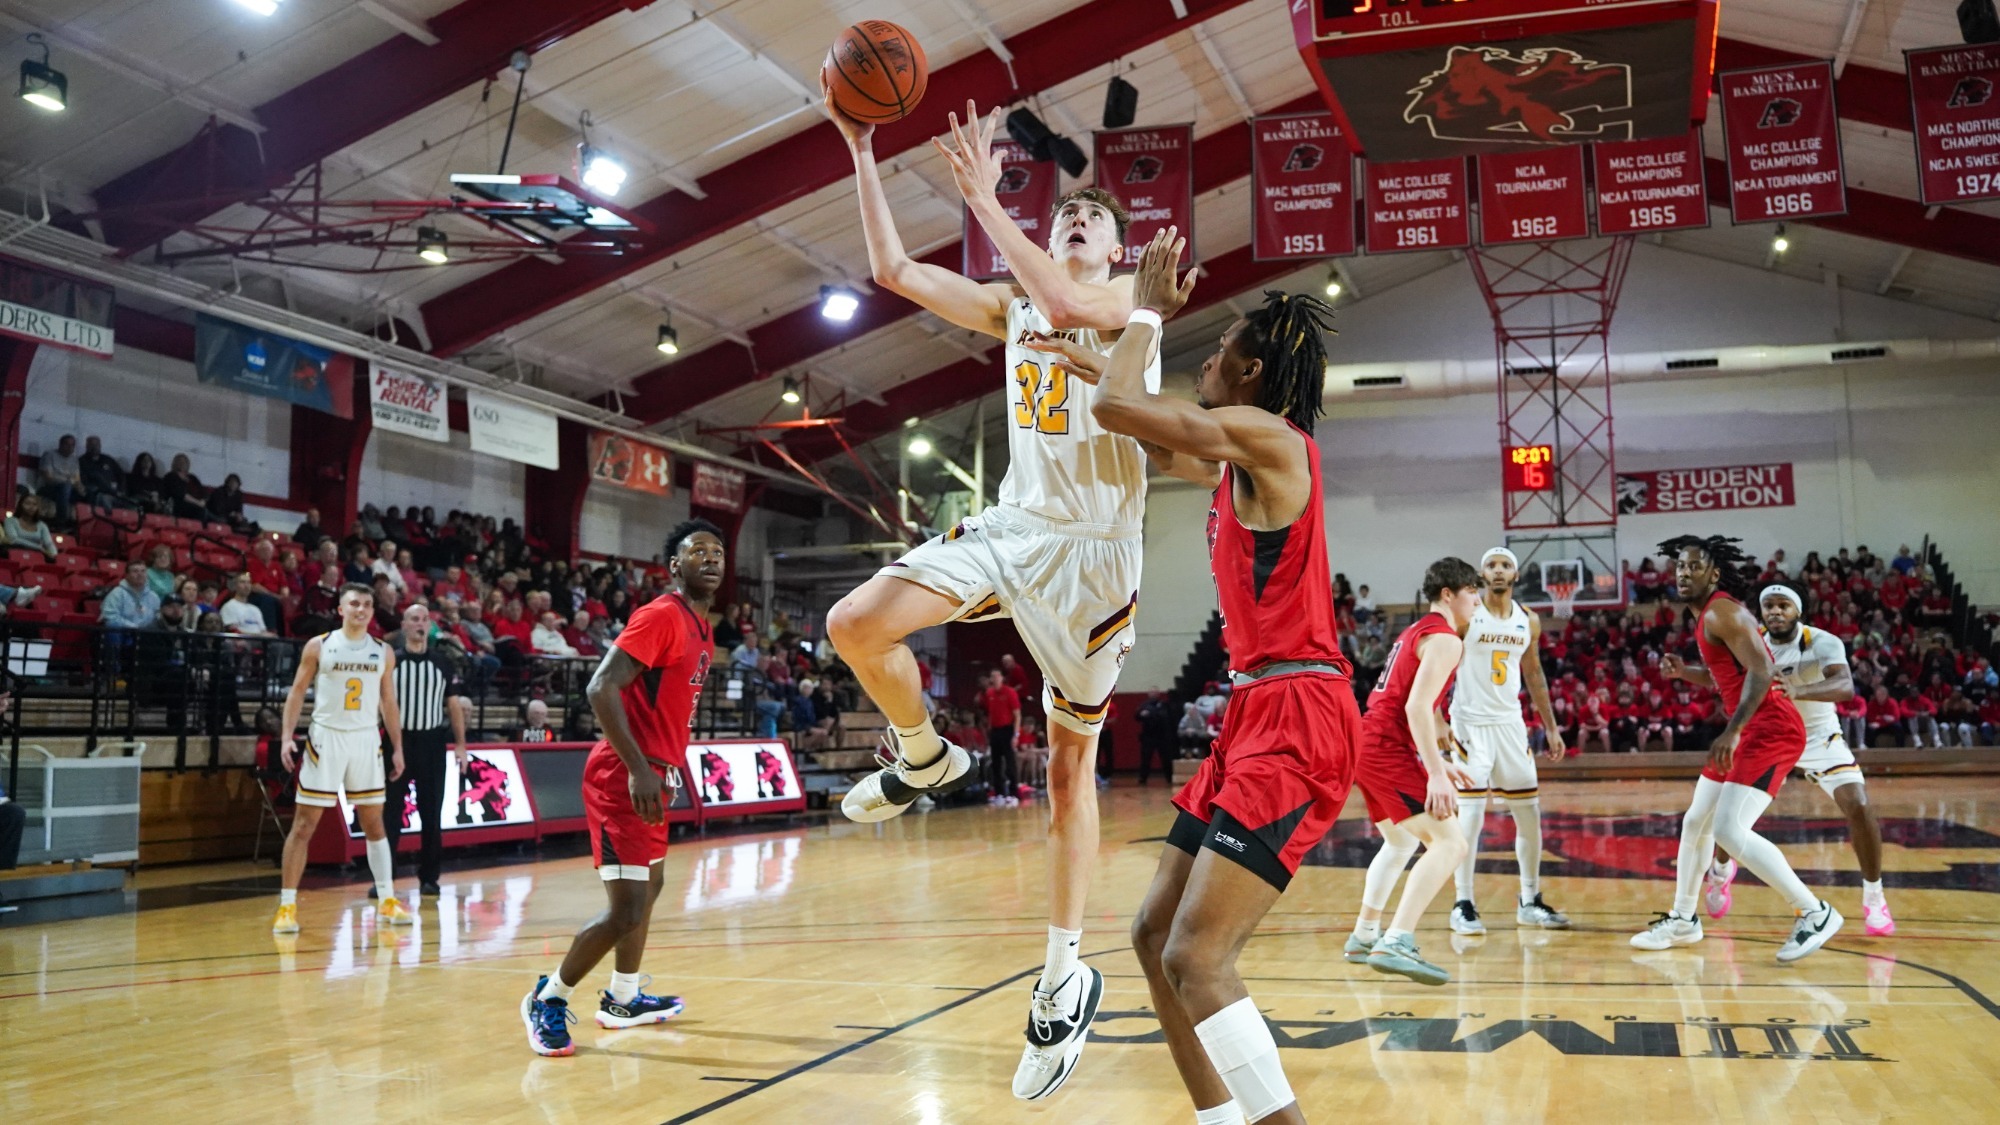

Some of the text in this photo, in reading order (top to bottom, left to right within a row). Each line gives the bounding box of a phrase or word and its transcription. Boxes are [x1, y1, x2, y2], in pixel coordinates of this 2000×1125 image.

[1379, 10, 1419, 28] T.O.L.
[1752, 71, 1795, 84] MEN'S
[1733, 78, 1821, 98] BASKETBALL
[1263, 126, 1342, 142] BASKETBALL
[1928, 123, 1954, 136] MAC
[1743, 137, 1822, 156] MAC COLLEGE
[1609, 151, 1687, 169] MAC COLLEGE
[1750, 153, 1818, 171] CHAMPIONS
[1929, 153, 2000, 172] NCAA SWEE
[1515, 165, 1546, 178] NCAA
[1616, 166, 1682, 183] CHAMPIONS
[1265, 182, 1341, 198] MAC WESTERN
[1379, 173, 1451, 190] MAC COLLEGE
[1495, 177, 1567, 194] TOURNAMENT
[1734, 170, 1837, 192] NCAA TOURNAMENT
[1956, 174, 2000, 196] 1974
[1130, 196, 1153, 208] MAC
[1384, 188, 1448, 204] CHAMPIONS
[1601, 184, 1700, 204] NCAA TOURNAMENT
[1274, 197, 1332, 212] CHAMPIONS
[1765, 193, 1813, 215] 1966
[1375, 206, 1459, 223] NCAA SWEET 16
[1629, 205, 1676, 227] 1965
[1396, 226, 1438, 246] 1961
[1511, 216, 1557, 238] 1962
[1283, 234, 1325, 254] 1951
[1014, 360, 1069, 435] 32
[1512, 447, 1550, 464] 12:07
[1524, 463, 1545, 487] 16
[1656, 465, 1782, 491] STUDENT
[1656, 486, 1783, 512] SECTION
[1478, 633, 1525, 646] ALVERNIA
[332, 662, 378, 672] ALVERNIA
[1491, 650, 1509, 686] 5
[344, 678, 363, 711] 2
